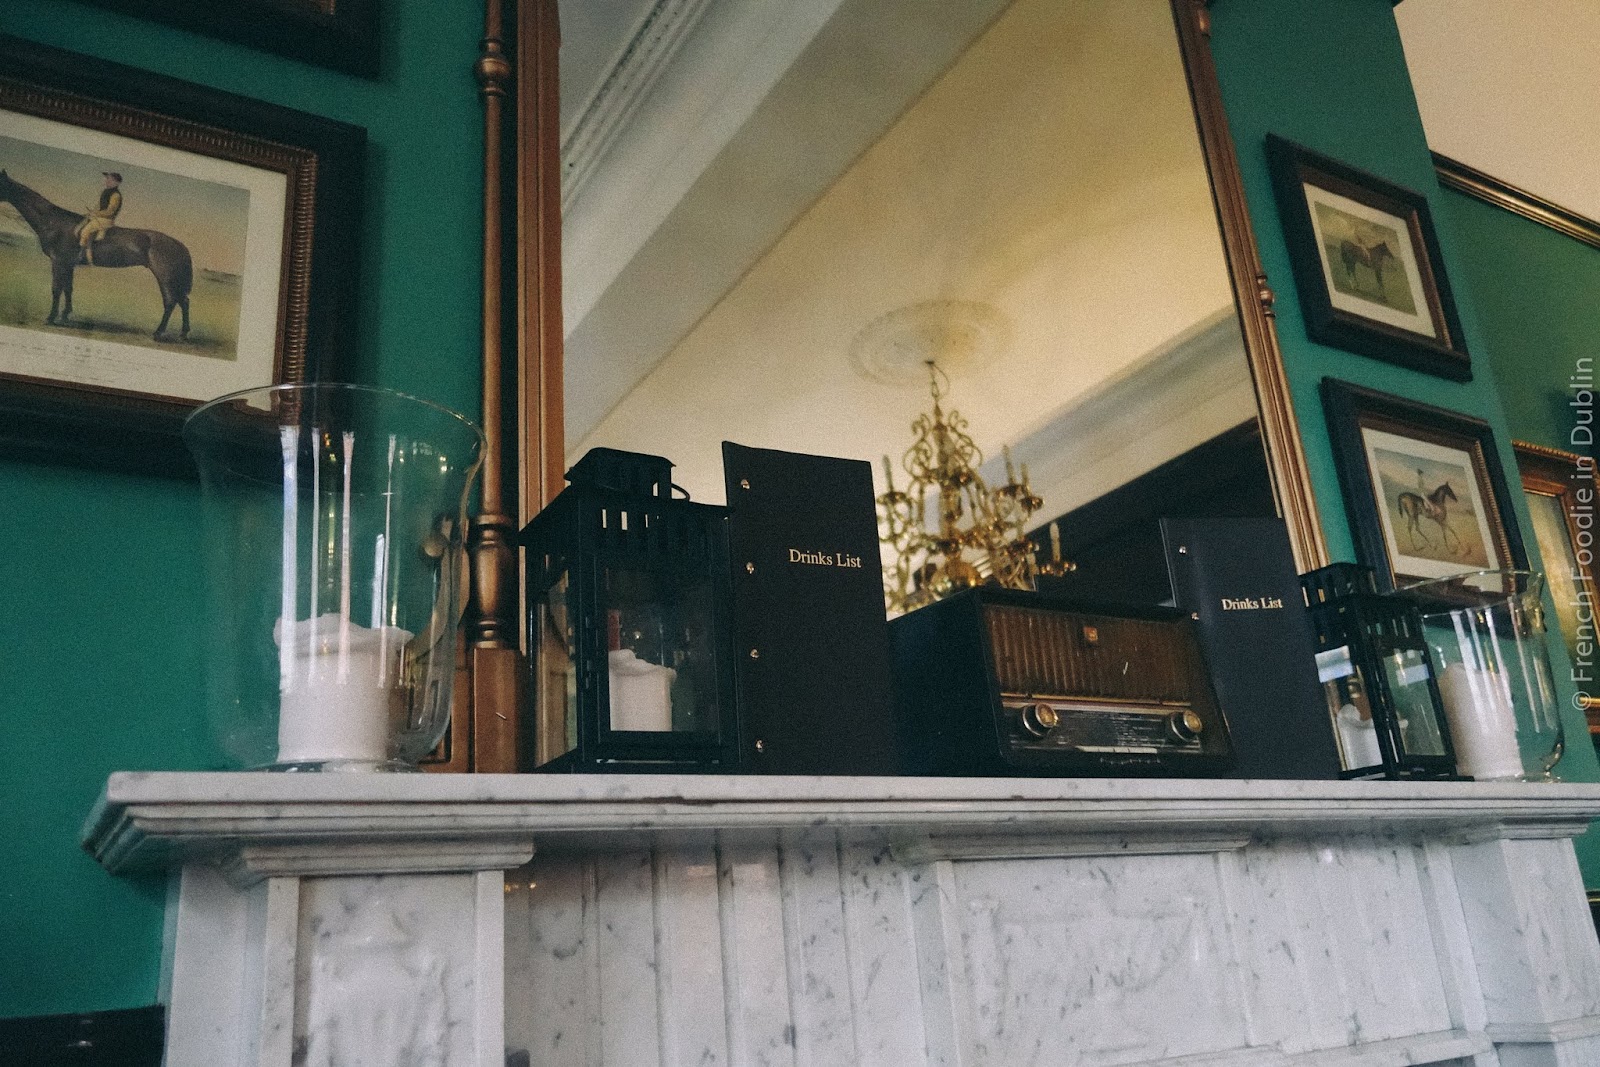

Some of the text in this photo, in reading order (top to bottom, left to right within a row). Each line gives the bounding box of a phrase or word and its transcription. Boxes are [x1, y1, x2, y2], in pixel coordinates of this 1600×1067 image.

[788, 548, 862, 568] Drinks List
[1221, 596, 1284, 611] Drinks List
